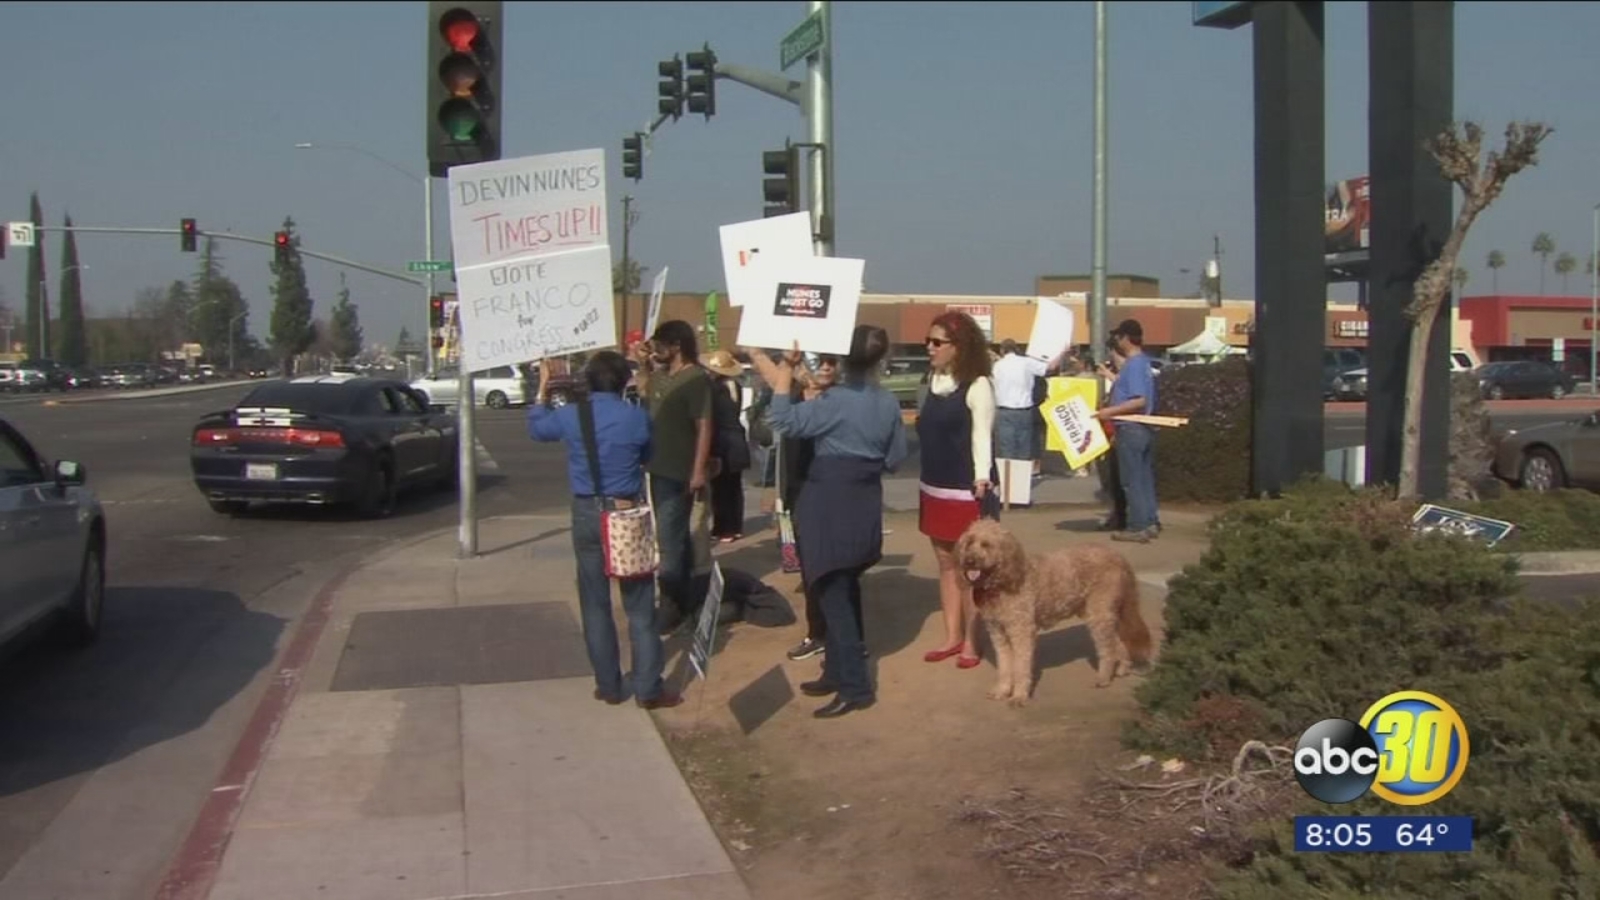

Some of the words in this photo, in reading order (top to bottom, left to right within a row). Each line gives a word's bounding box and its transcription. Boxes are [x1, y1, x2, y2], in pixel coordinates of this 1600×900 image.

[460, 173, 530, 206] DEVIN
[534, 165, 600, 192] NUNES
[473, 212, 553, 254] TIMES
[473, 283, 591, 317] FRANCO
[780, 297, 807, 307] MUST
[809, 299, 824, 308] GO
[786, 289, 821, 299] NUNES
[477, 326, 563, 360] CONGRESS
[1055, 404, 1081, 443] FRANCO
